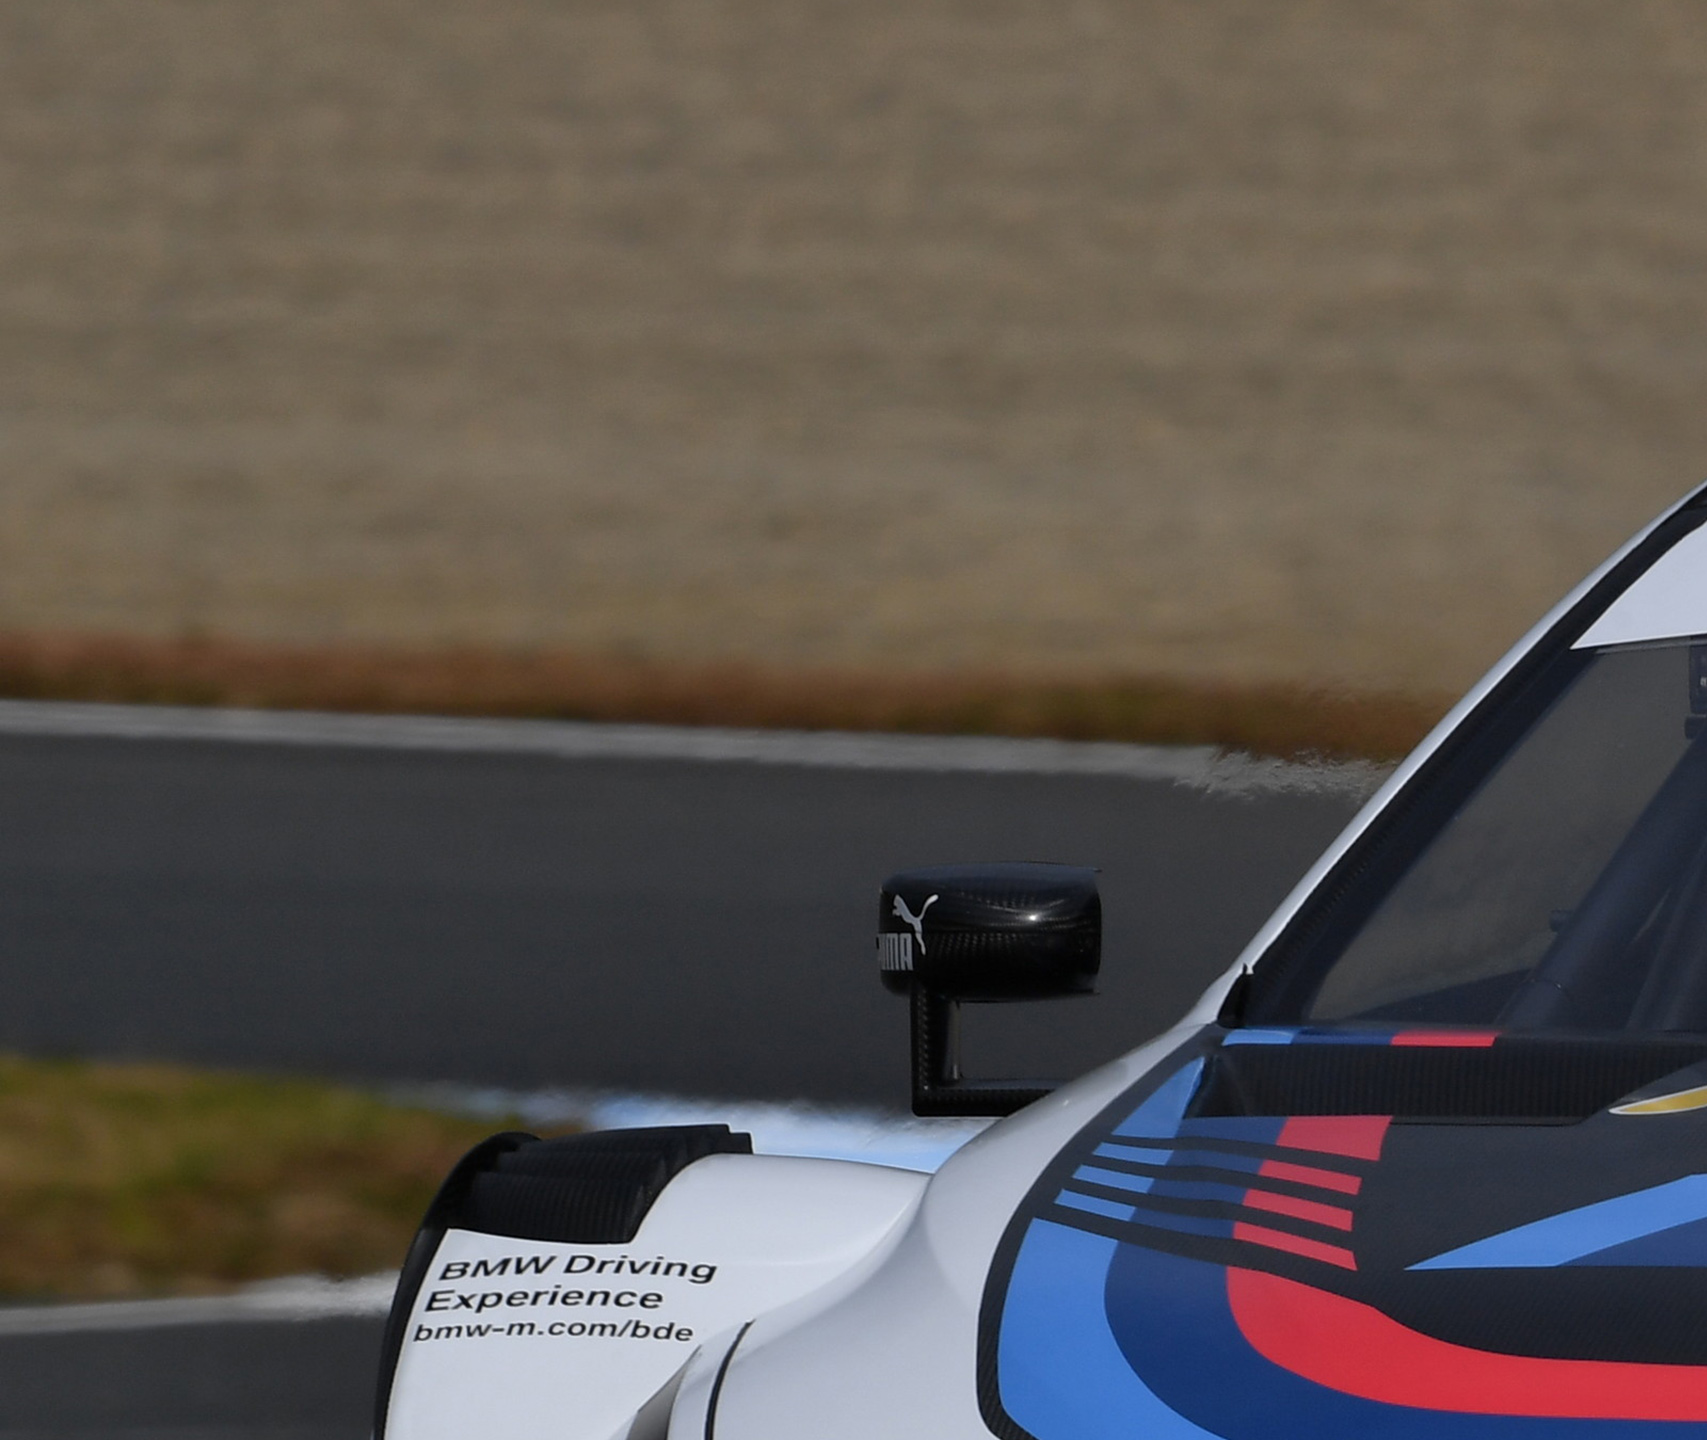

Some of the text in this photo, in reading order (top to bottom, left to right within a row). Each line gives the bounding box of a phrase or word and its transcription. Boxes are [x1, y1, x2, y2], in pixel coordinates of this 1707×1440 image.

[439, 1254, 717, 1285] BMW Driving
[424, 1285, 664, 1313] Experience
[412, 1319, 694, 1343] bmw-m.com/bde
